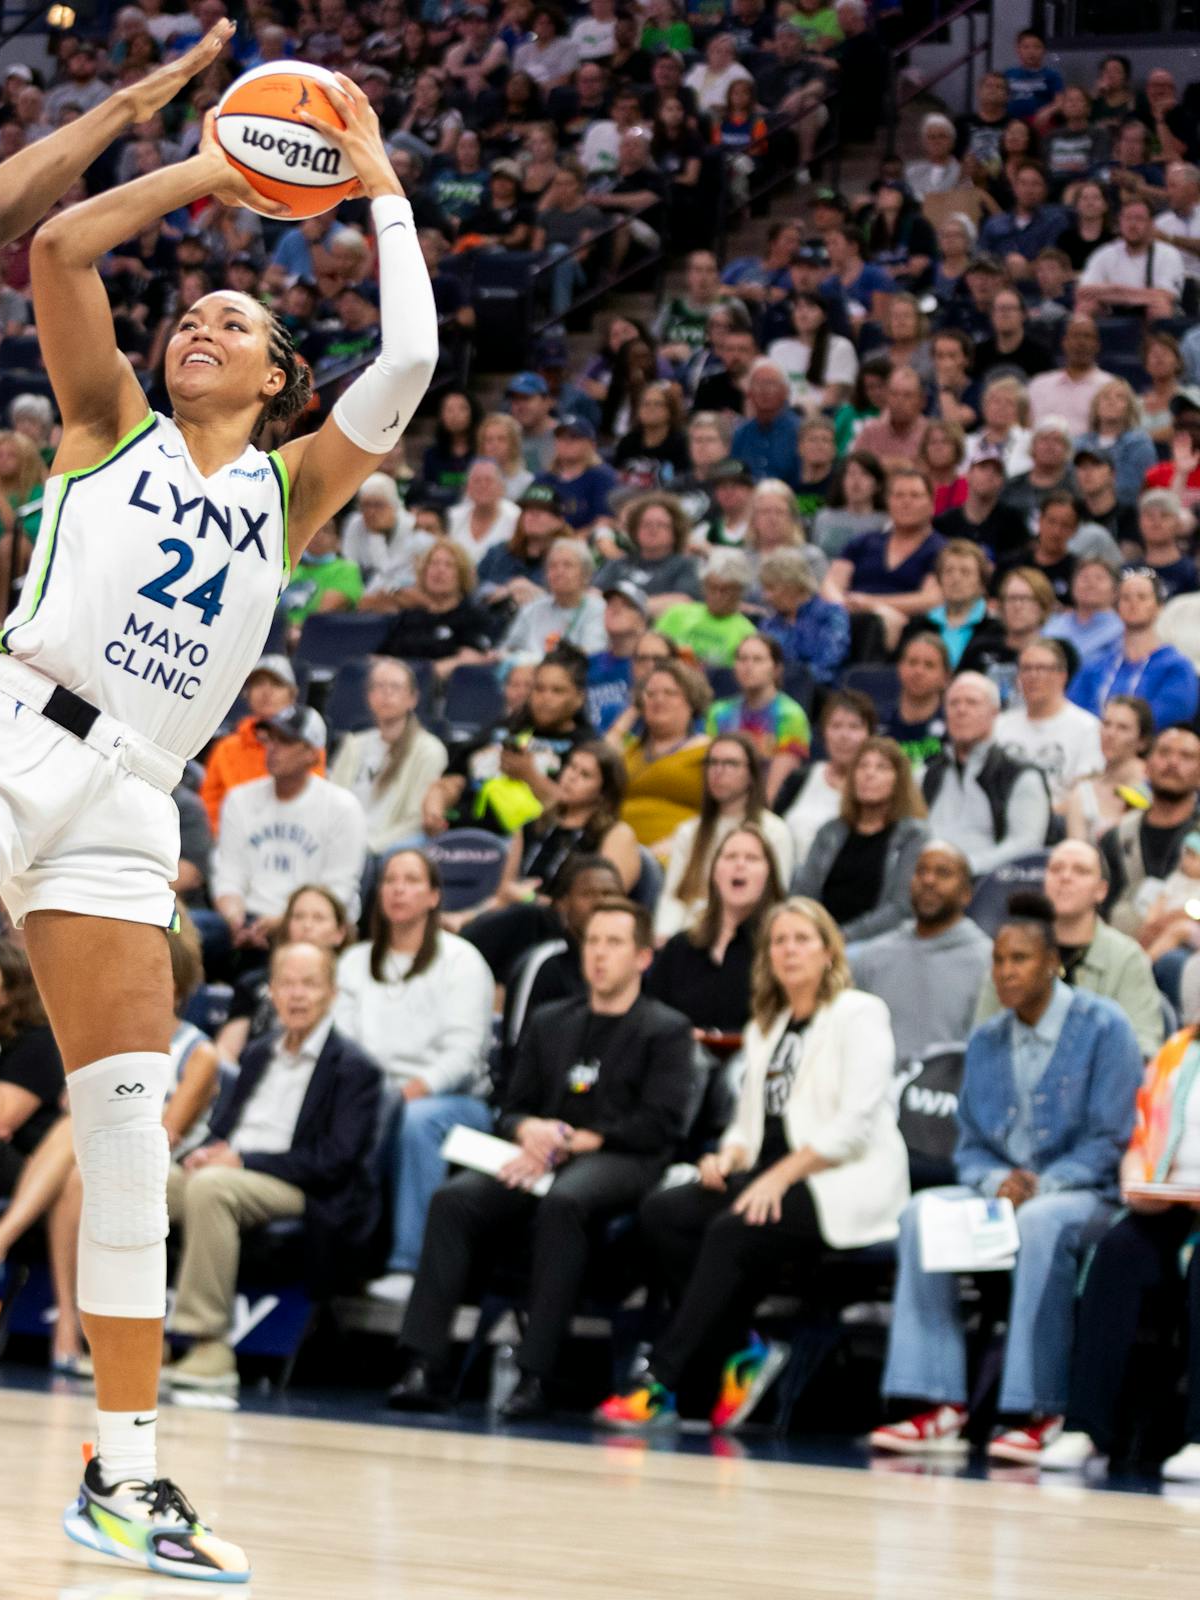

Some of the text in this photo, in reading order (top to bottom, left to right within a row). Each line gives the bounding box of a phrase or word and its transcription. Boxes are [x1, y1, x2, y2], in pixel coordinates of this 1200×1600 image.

[242, 125, 341, 175] Wilson
[128, 470, 269, 561] LYNX
[137, 538, 230, 627] 24
[123, 612, 209, 667] MAYO
[104, 640, 201, 700] CLINIC
